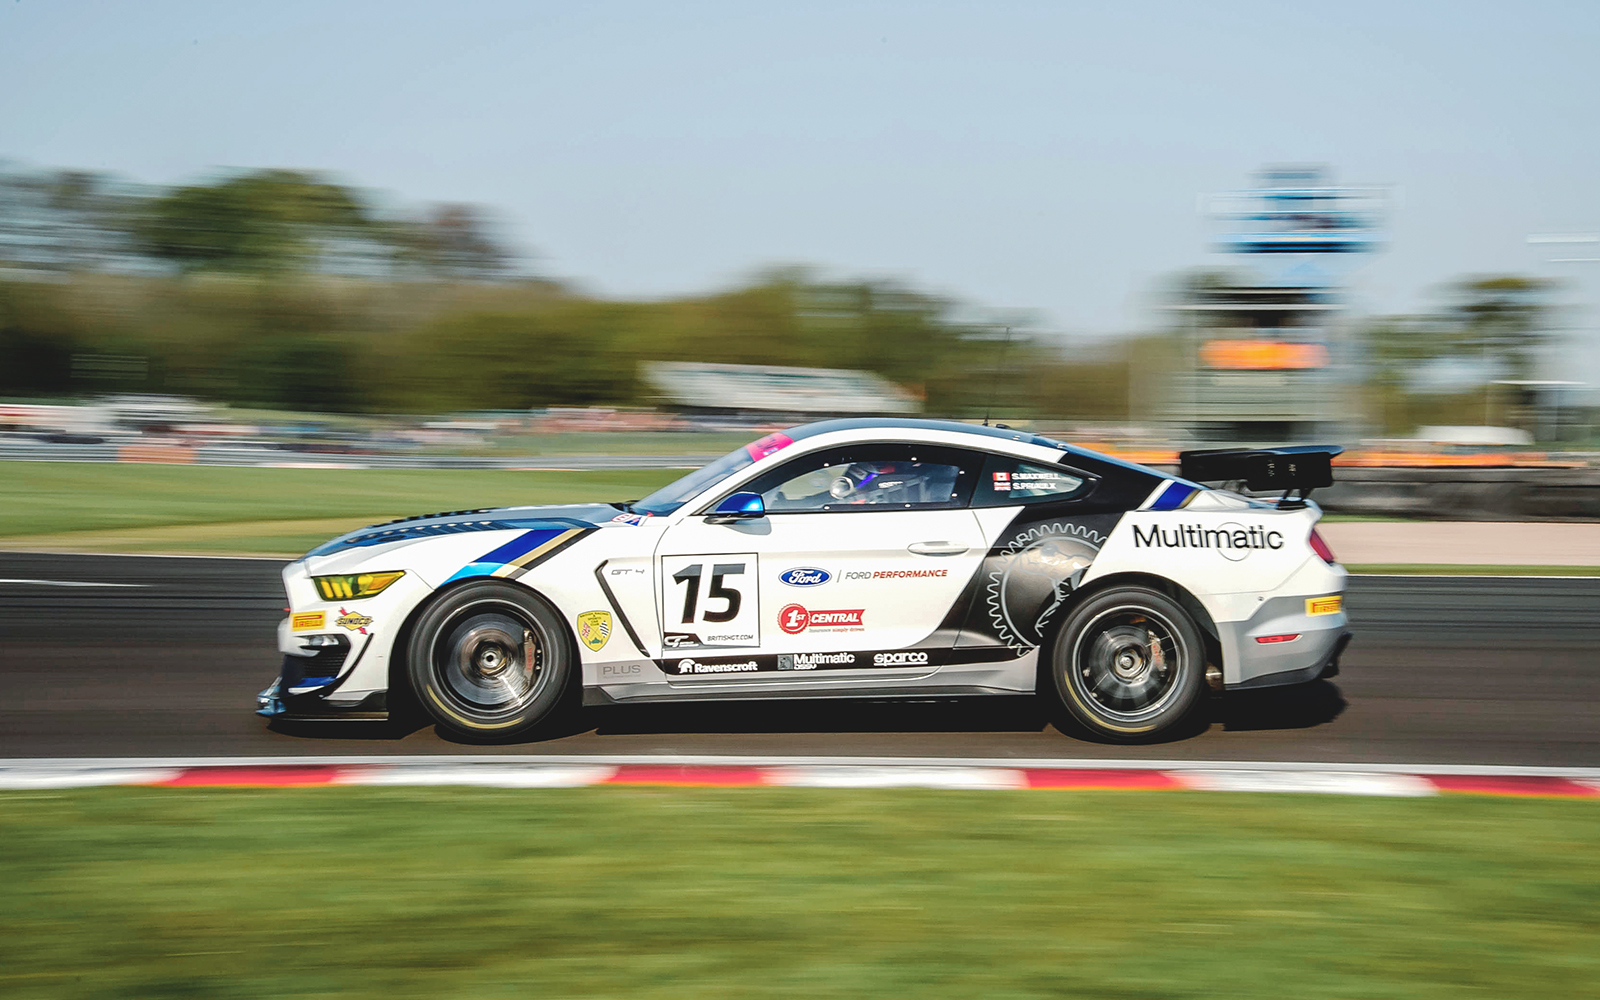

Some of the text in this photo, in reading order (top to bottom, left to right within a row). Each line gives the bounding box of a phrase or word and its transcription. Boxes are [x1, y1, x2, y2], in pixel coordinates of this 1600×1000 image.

[1132, 524, 1285, 550] Multimatic
[788, 570, 821, 584] Ford
[845, 570, 948, 579] FORD PERFORMANCE
[672, 563, 746, 624] 15
[811, 612, 859, 624] CENTRAL
[794, 652, 855, 665] Multimatic
[874, 652, 928, 665] sparco
[603, 665, 641, 675] PLUS
[694, 660, 758, 674] Ravenscroft
